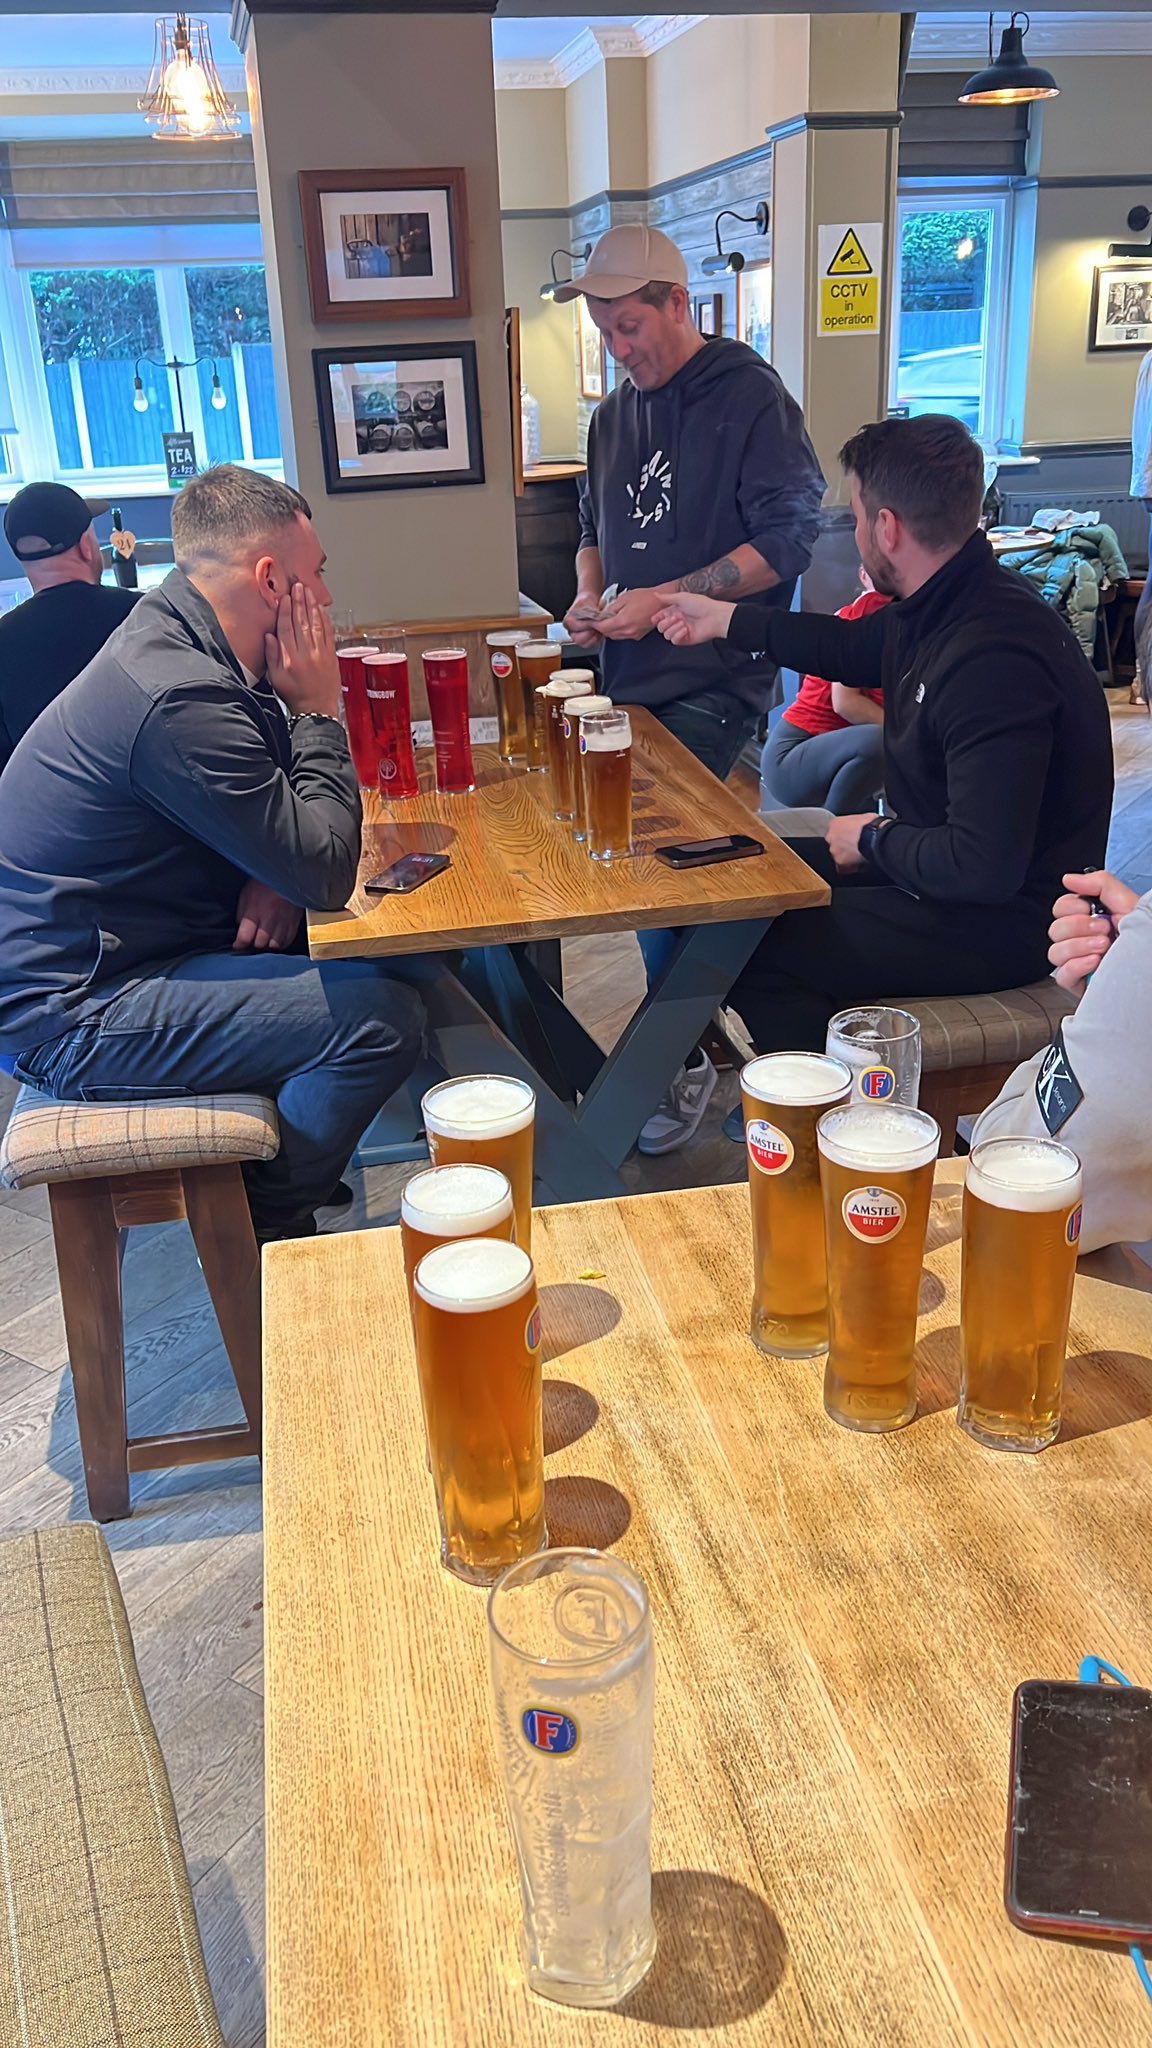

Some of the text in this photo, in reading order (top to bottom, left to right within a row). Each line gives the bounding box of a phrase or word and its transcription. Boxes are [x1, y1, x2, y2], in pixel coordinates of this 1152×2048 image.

[830, 283, 868, 298] CCTV
[844, 300, 854, 311] in
[824, 313, 873, 328] operation
[167, 448, 193, 463] TEA
[868, 1072, 887, 1097] F
[750, 1133, 785, 1152] AMSTEL
[757, 1149, 773, 1160] BIER
[851, 1203, 898, 1216] AMSTEL
[862, 1217, 884, 1226] BIER
[533, 1710, 564, 1751] F
